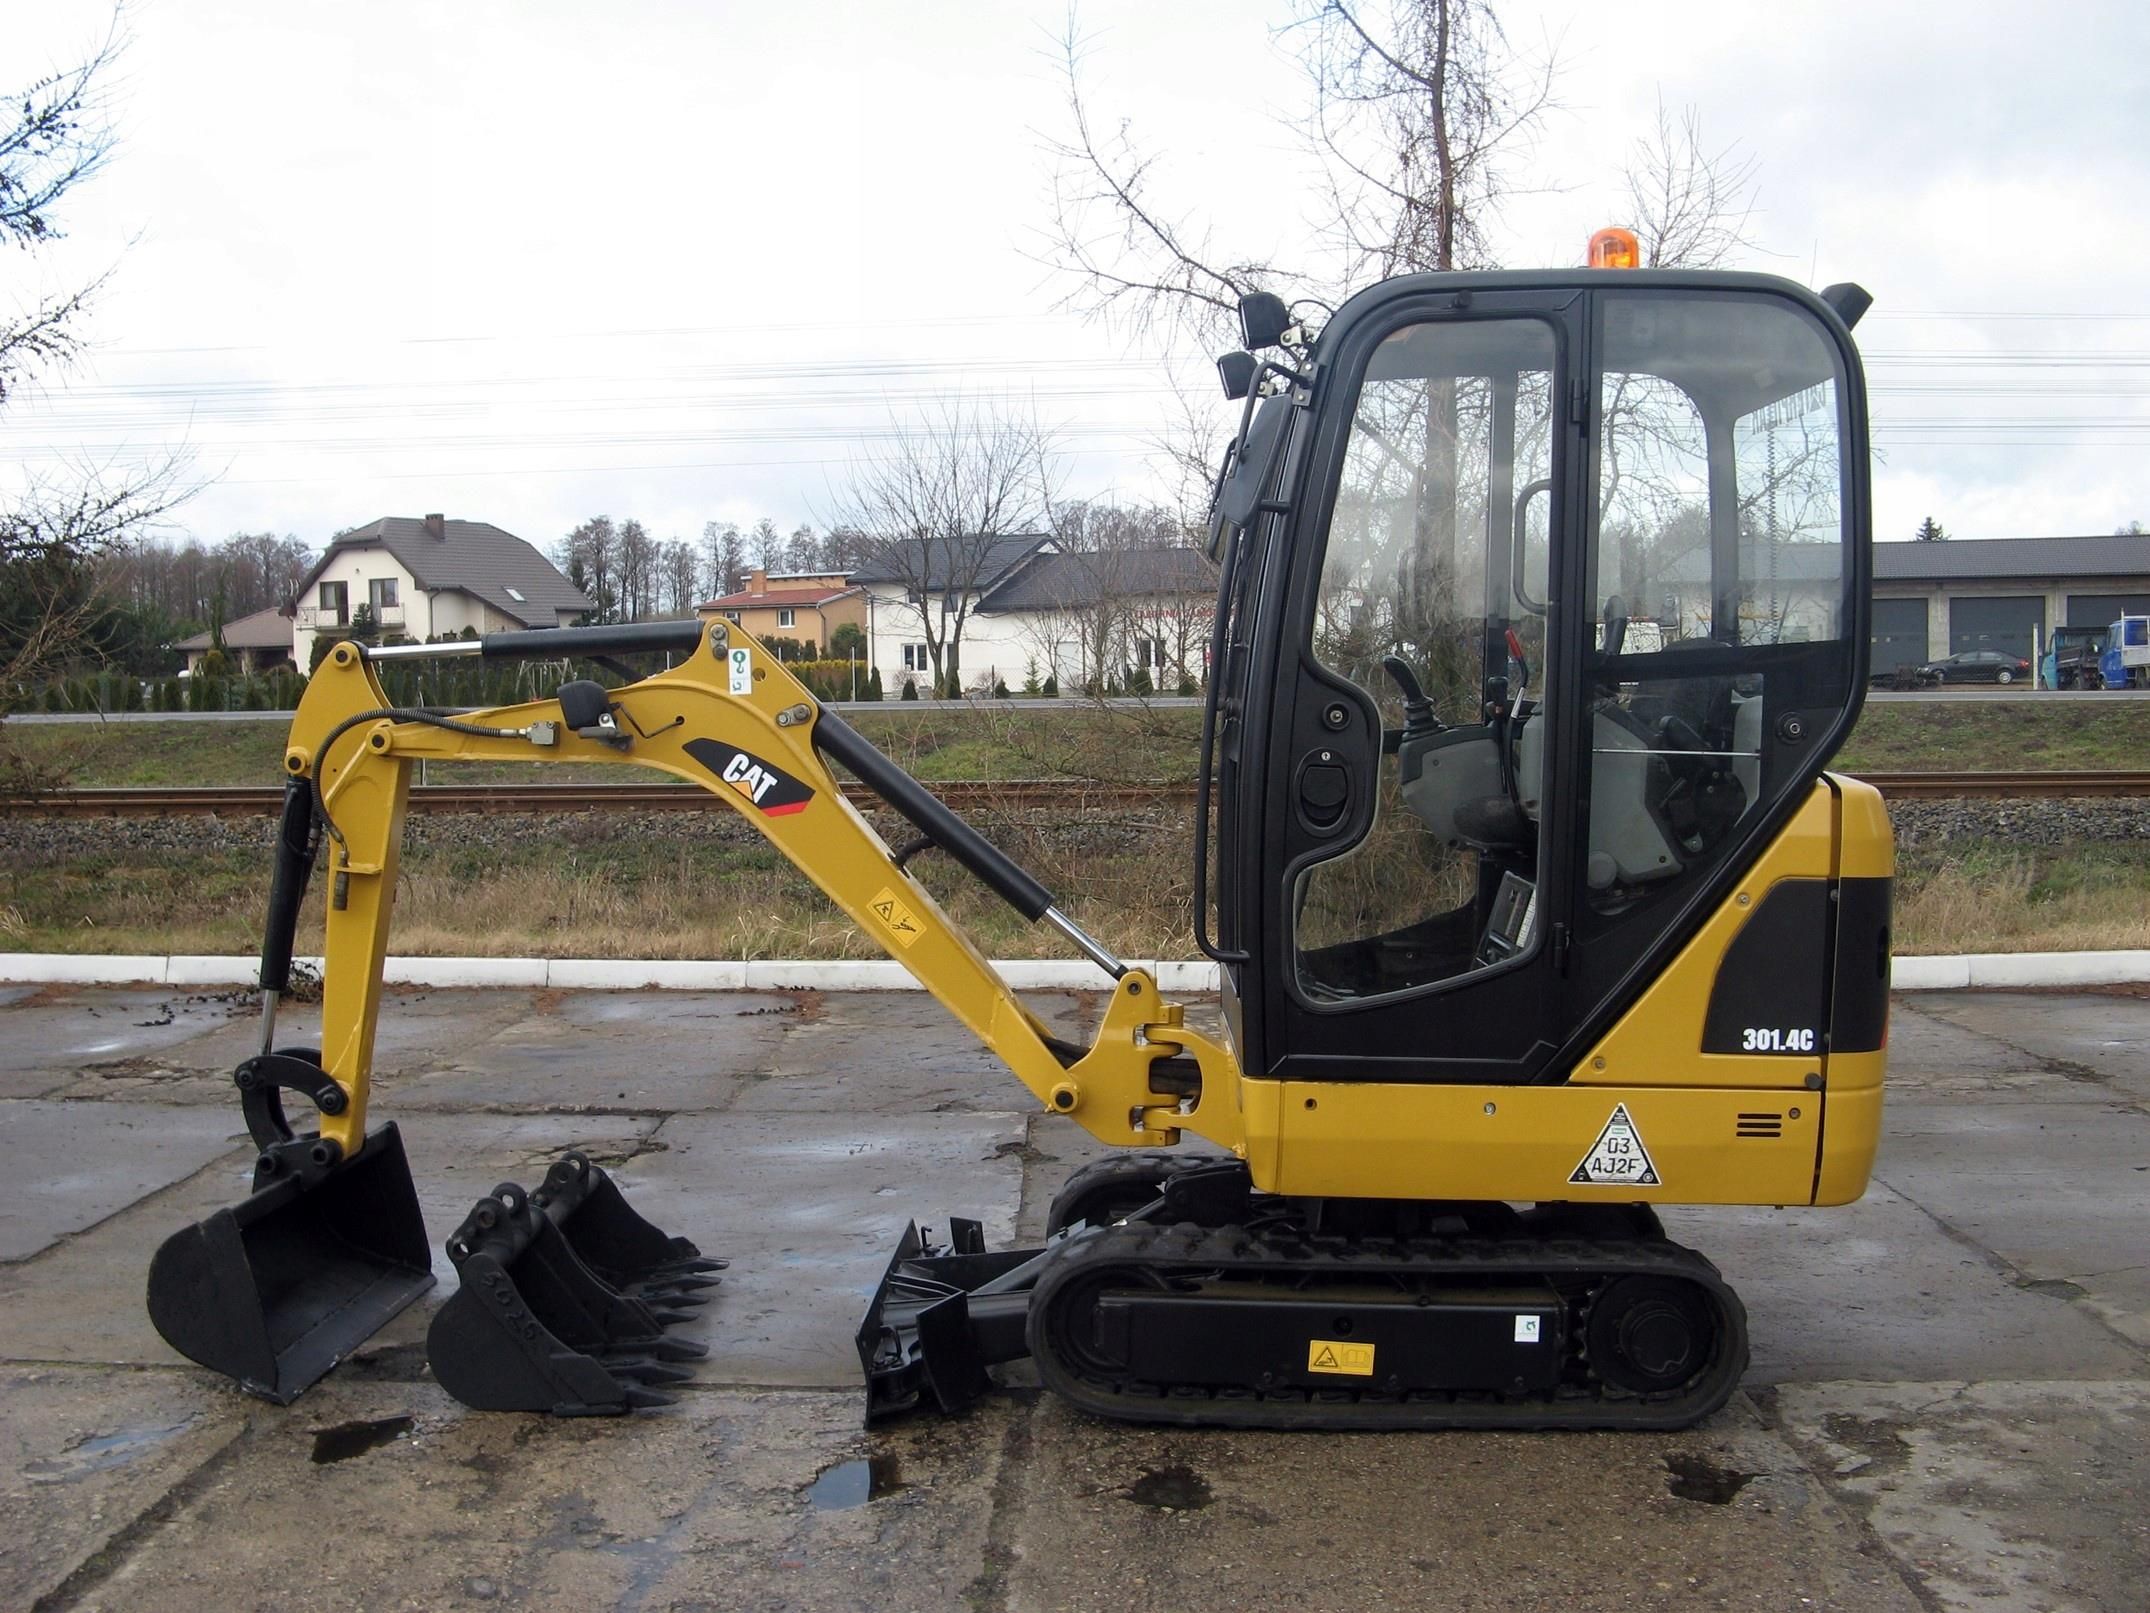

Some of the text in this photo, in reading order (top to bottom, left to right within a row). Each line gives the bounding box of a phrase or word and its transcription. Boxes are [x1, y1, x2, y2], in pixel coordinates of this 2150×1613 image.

[722, 753, 778, 804] CAT
[1742, 1028, 1814, 1051] 301.4C
[1591, 1157, 1640, 1174] AJ2F
